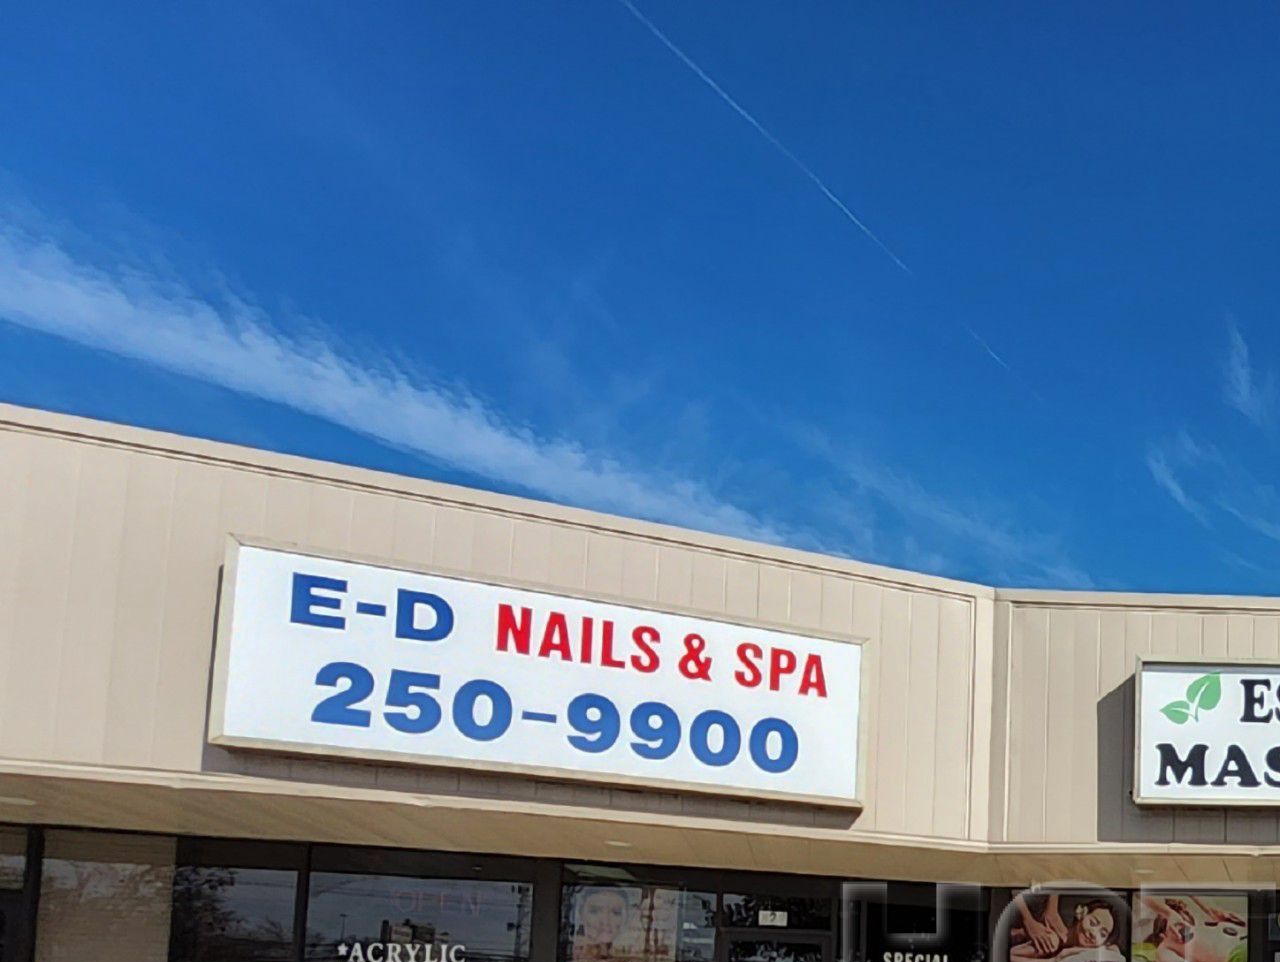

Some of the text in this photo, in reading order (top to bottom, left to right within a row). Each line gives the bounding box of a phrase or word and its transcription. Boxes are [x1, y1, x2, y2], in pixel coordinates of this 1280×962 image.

[290, 572, 828, 698] E-D NAILS & SPA
[310, 661, 799, 774] 250-9900
